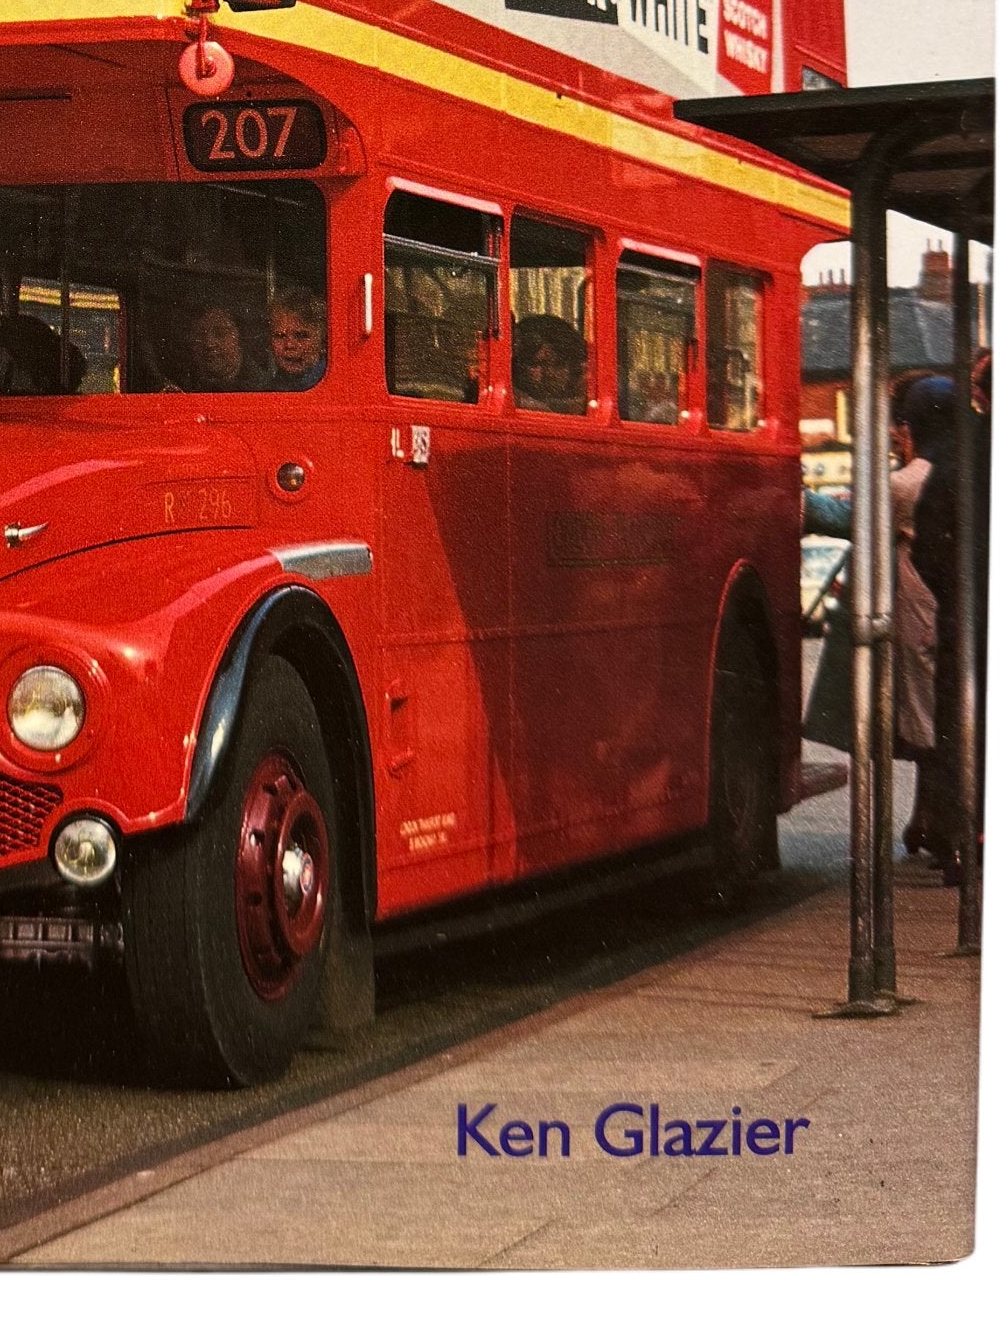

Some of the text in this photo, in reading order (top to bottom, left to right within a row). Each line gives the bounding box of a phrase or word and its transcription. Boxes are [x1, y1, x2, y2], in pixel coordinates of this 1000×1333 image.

[723, 29, 769, 75] WHISKY
[201, 107, 297, 159] 207
[457, 1102, 811, 1158] Ken Glazier
